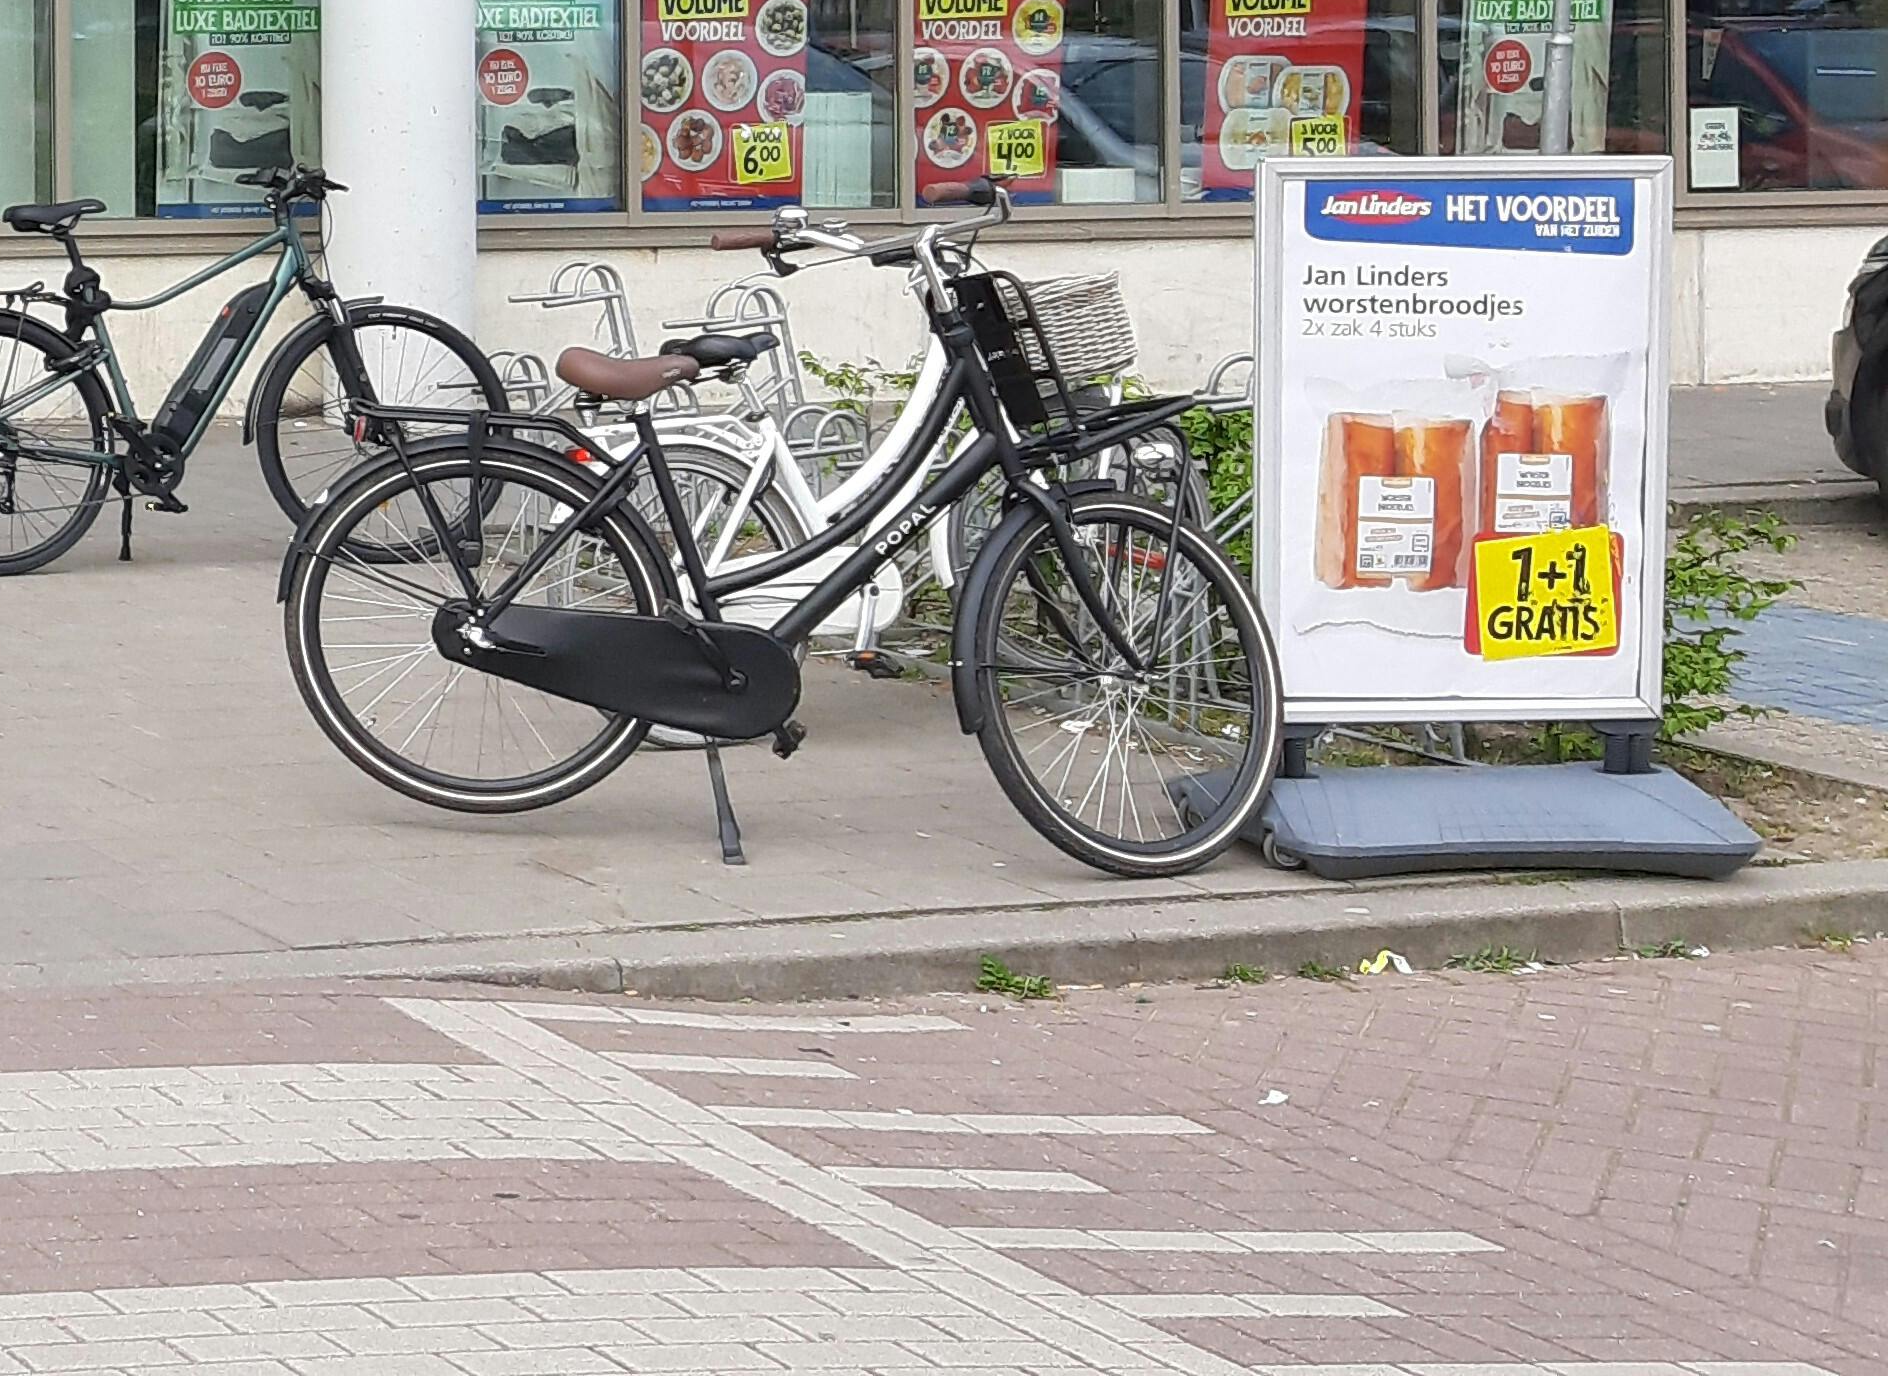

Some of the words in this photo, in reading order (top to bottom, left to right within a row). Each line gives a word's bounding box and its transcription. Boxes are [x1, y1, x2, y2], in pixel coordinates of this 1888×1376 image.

[176, 10, 218, 31] LUXE
[223, 9, 318, 31] BADTEXTIEL
[508, 7, 599, 28] BADTEXTIEL
[1476, 0, 1512, 20] LUXE
[661, 21, 746, 41] VOORDEEL
[922, 21, 1003, 40] VOORDEEL
[1227, 17, 1307, 38] VOORDEEL
[1311, 123, 1338, 135] VOOR
[1321, 196, 1356, 216] Jan
[1359, 194, 1432, 216] Linders
[1446, 195, 1489, 221] HET
[1496, 195, 1620, 223] VOORDEEL
[1303, 265, 1346, 287] Jan
[1357, 264, 1448, 287] Linders
[1303, 293, 1523, 321] worstenbroodjes
[1302, 320, 1324, 337] 2x
[1331, 319, 1362, 337] zak
[1369, 320, 1382, 337] 4
[1388, 319, 1437, 337] stuks
[875, 504, 937, 555] POPAL
[1511, 543, 1592, 603] 1+1
[1487, 601, 1601, 642] GRATIS
